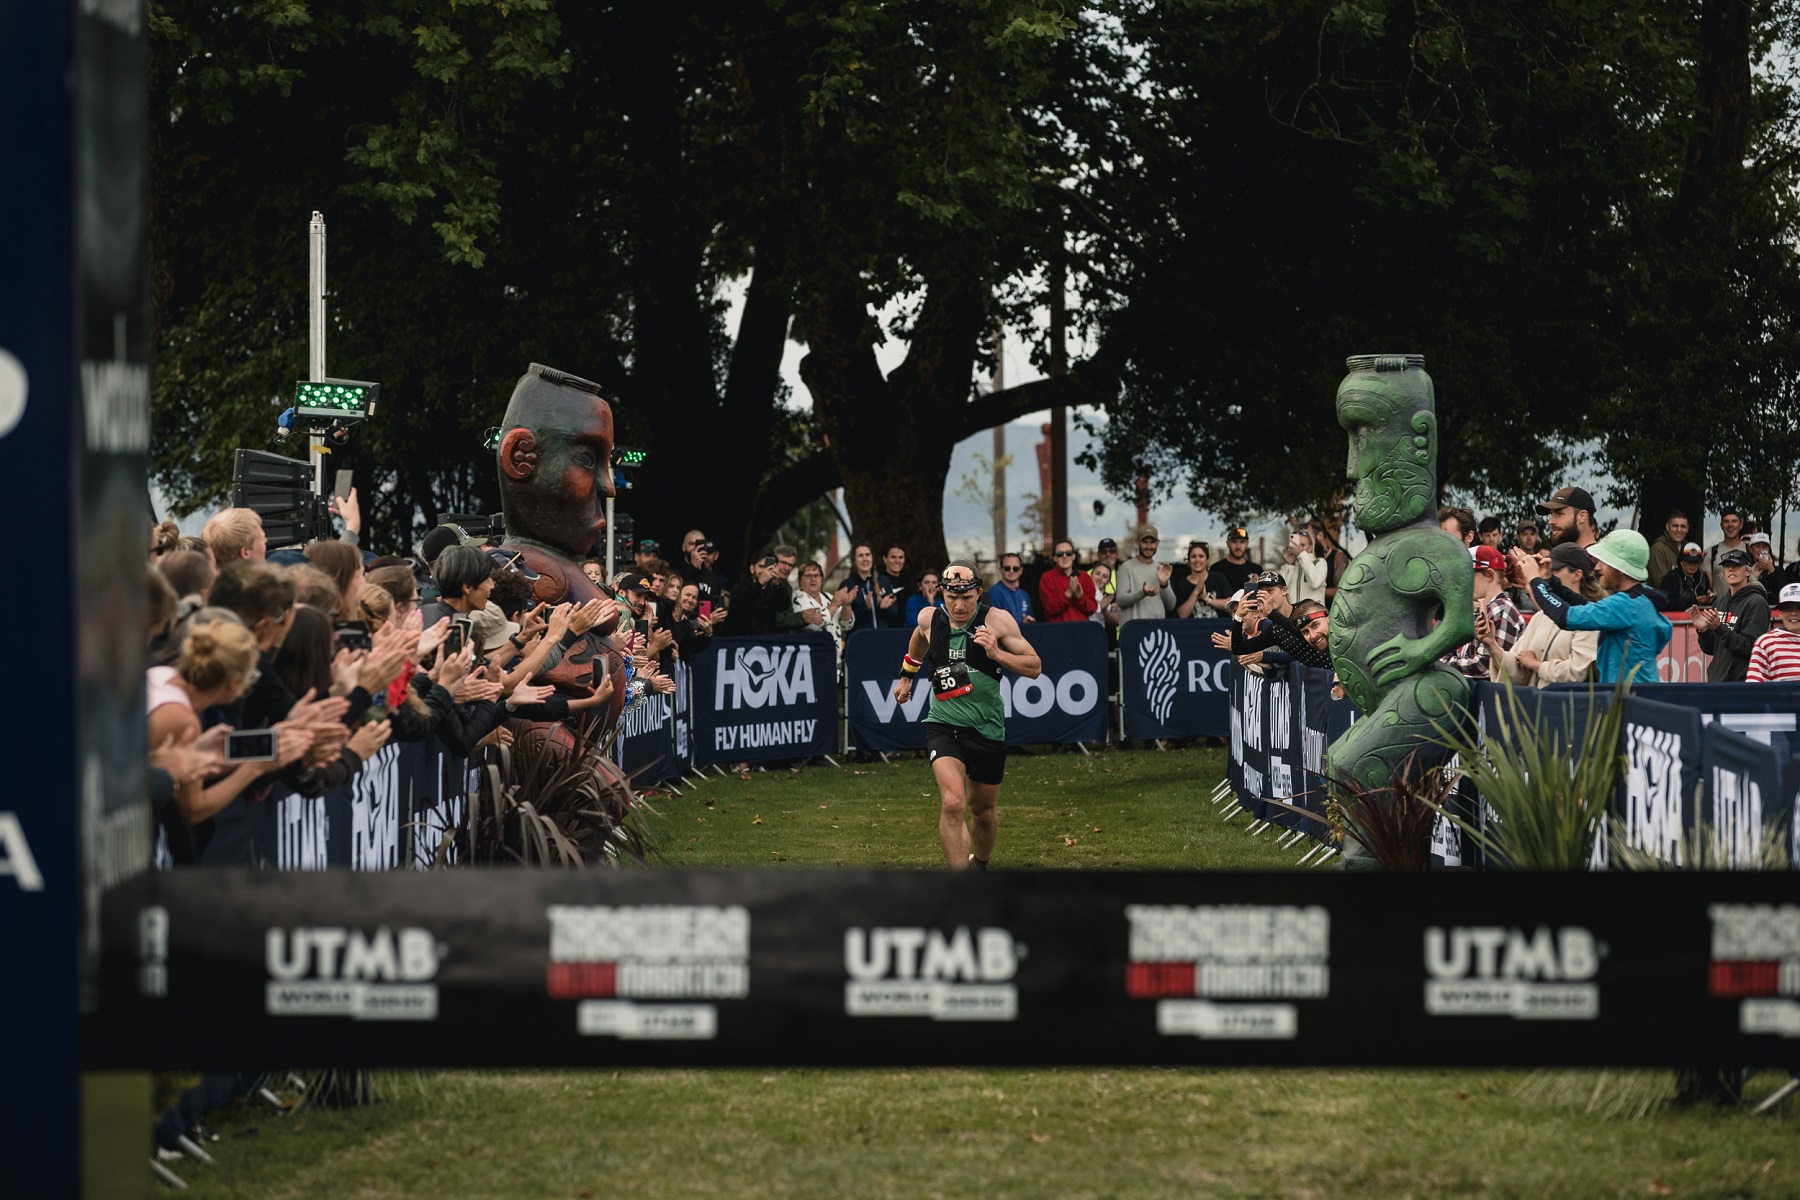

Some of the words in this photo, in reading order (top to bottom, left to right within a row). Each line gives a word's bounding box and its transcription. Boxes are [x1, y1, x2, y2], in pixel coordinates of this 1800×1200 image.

[715, 645, 816, 711] HOKA
[861, 669, 1098, 724] woo
[941, 677, 956, 690] 50
[715, 725, 738, 750] FLY
[740, 721, 792, 749] HUMAN
[794, 719, 816, 744] FLY
[1626, 722, 1683, 867] HOKA
[265, 924, 439, 982] UTMB
[844, 924, 1018, 982] UTMB
[1424, 923, 1599, 981] UTMB
